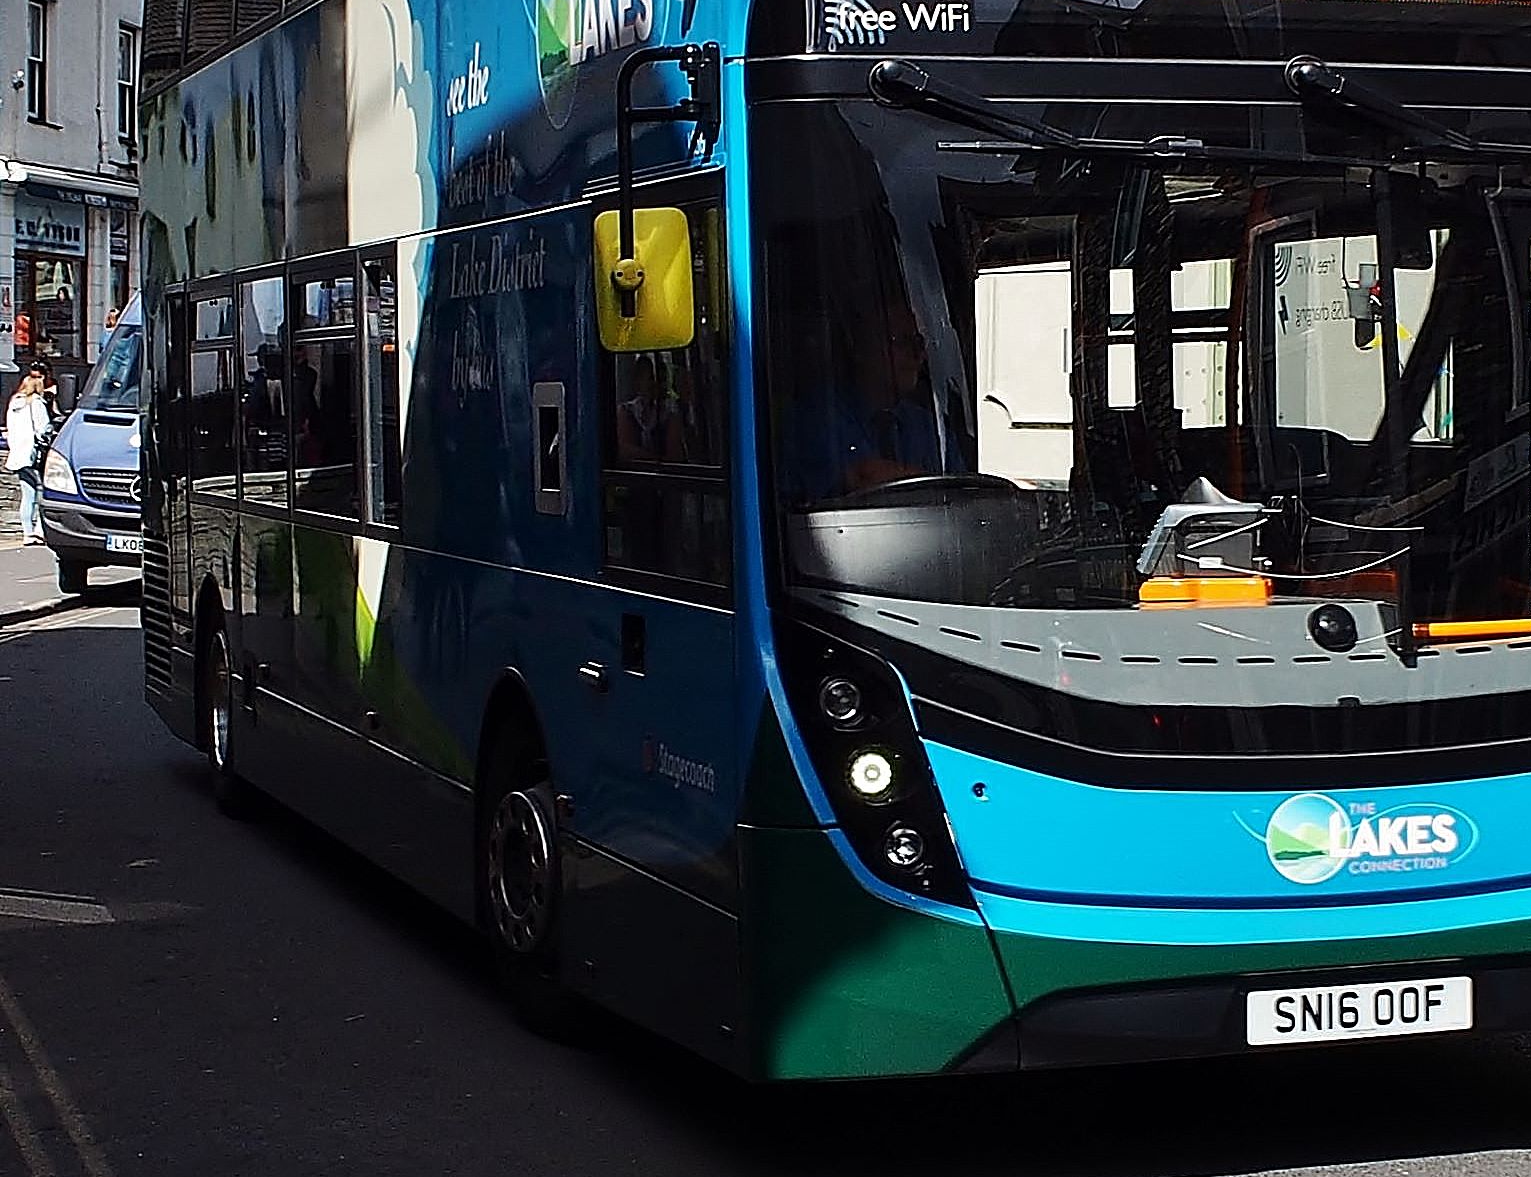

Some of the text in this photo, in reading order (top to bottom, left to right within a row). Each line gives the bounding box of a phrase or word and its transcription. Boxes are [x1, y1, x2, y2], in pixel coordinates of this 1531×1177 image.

[836, 1, 970, 32] free WiFi
[467, 41, 490, 110] the
[656, 741, 714, 793] Stagecoach
[1327, 809, 1459, 859] LAKES
[1349, 803, 1377, 815] THE
[1348, 856, 1448, 875] CONNECTION
[1274, 984, 1445, 1034] SN16 OOF
